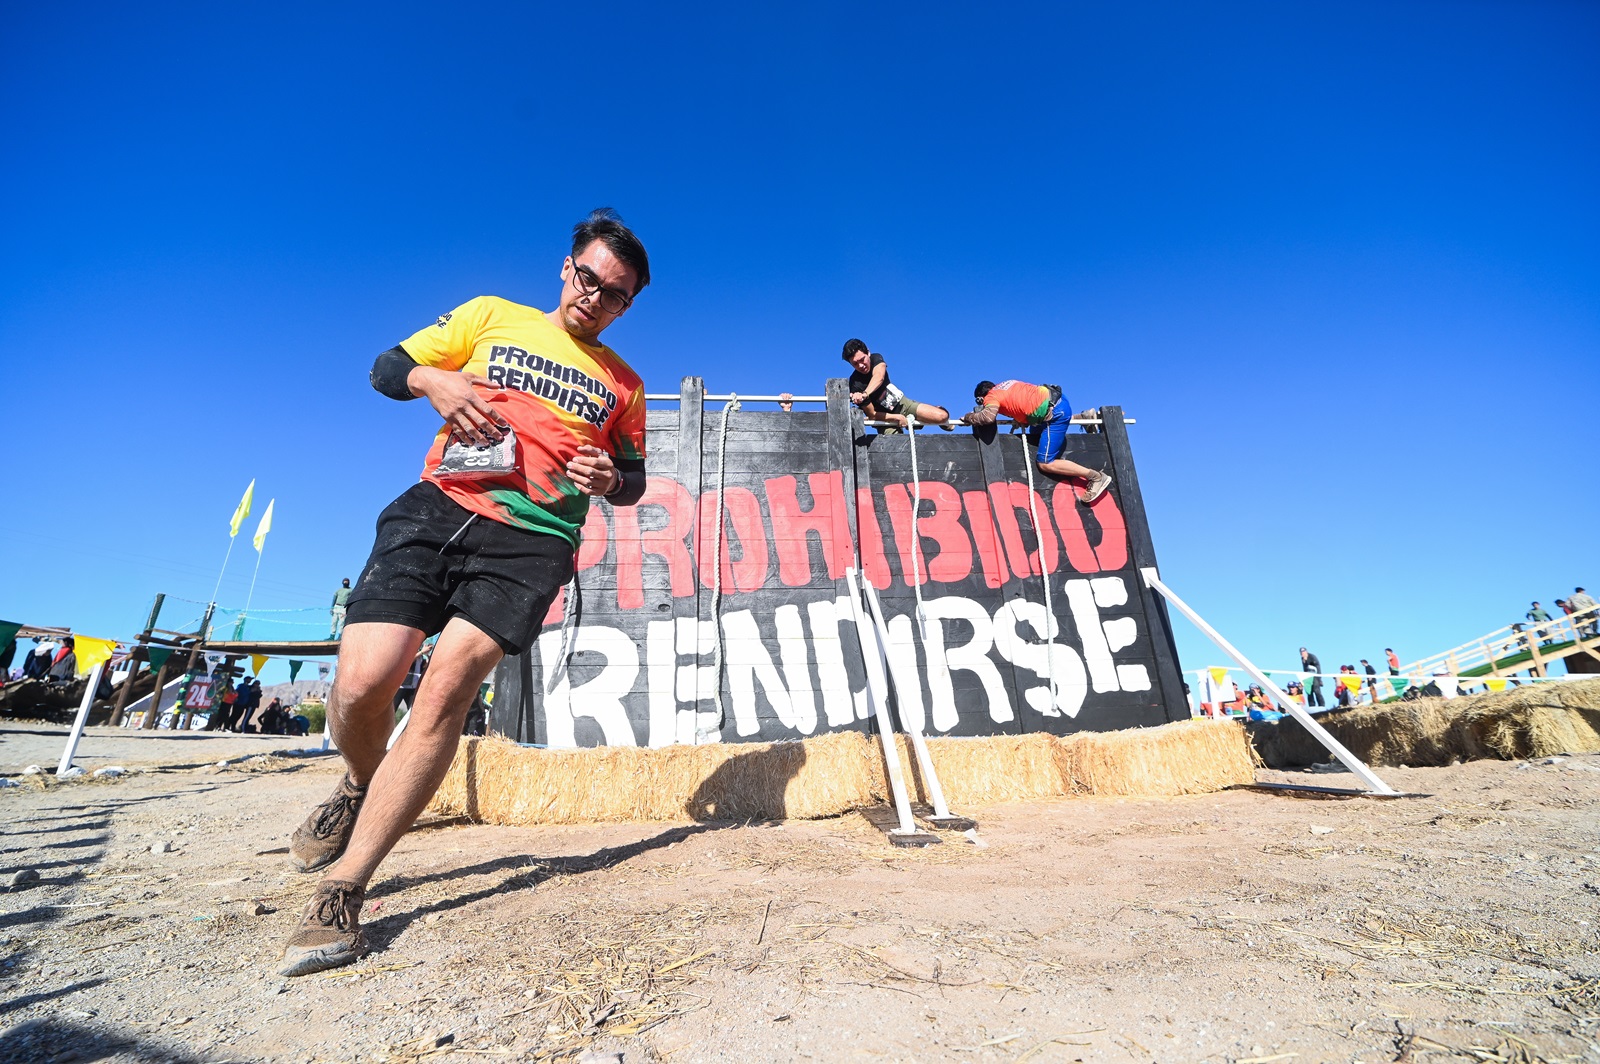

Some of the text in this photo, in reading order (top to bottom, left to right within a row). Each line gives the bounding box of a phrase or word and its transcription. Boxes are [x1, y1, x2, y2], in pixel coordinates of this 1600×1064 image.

[486, 364, 610, 432] RENDIRSE
[488, 344, 618, 412] PROHIBIDO
[185, 684, 208, 707] 24
[538, 577, 1152, 748] RENDIRSE
